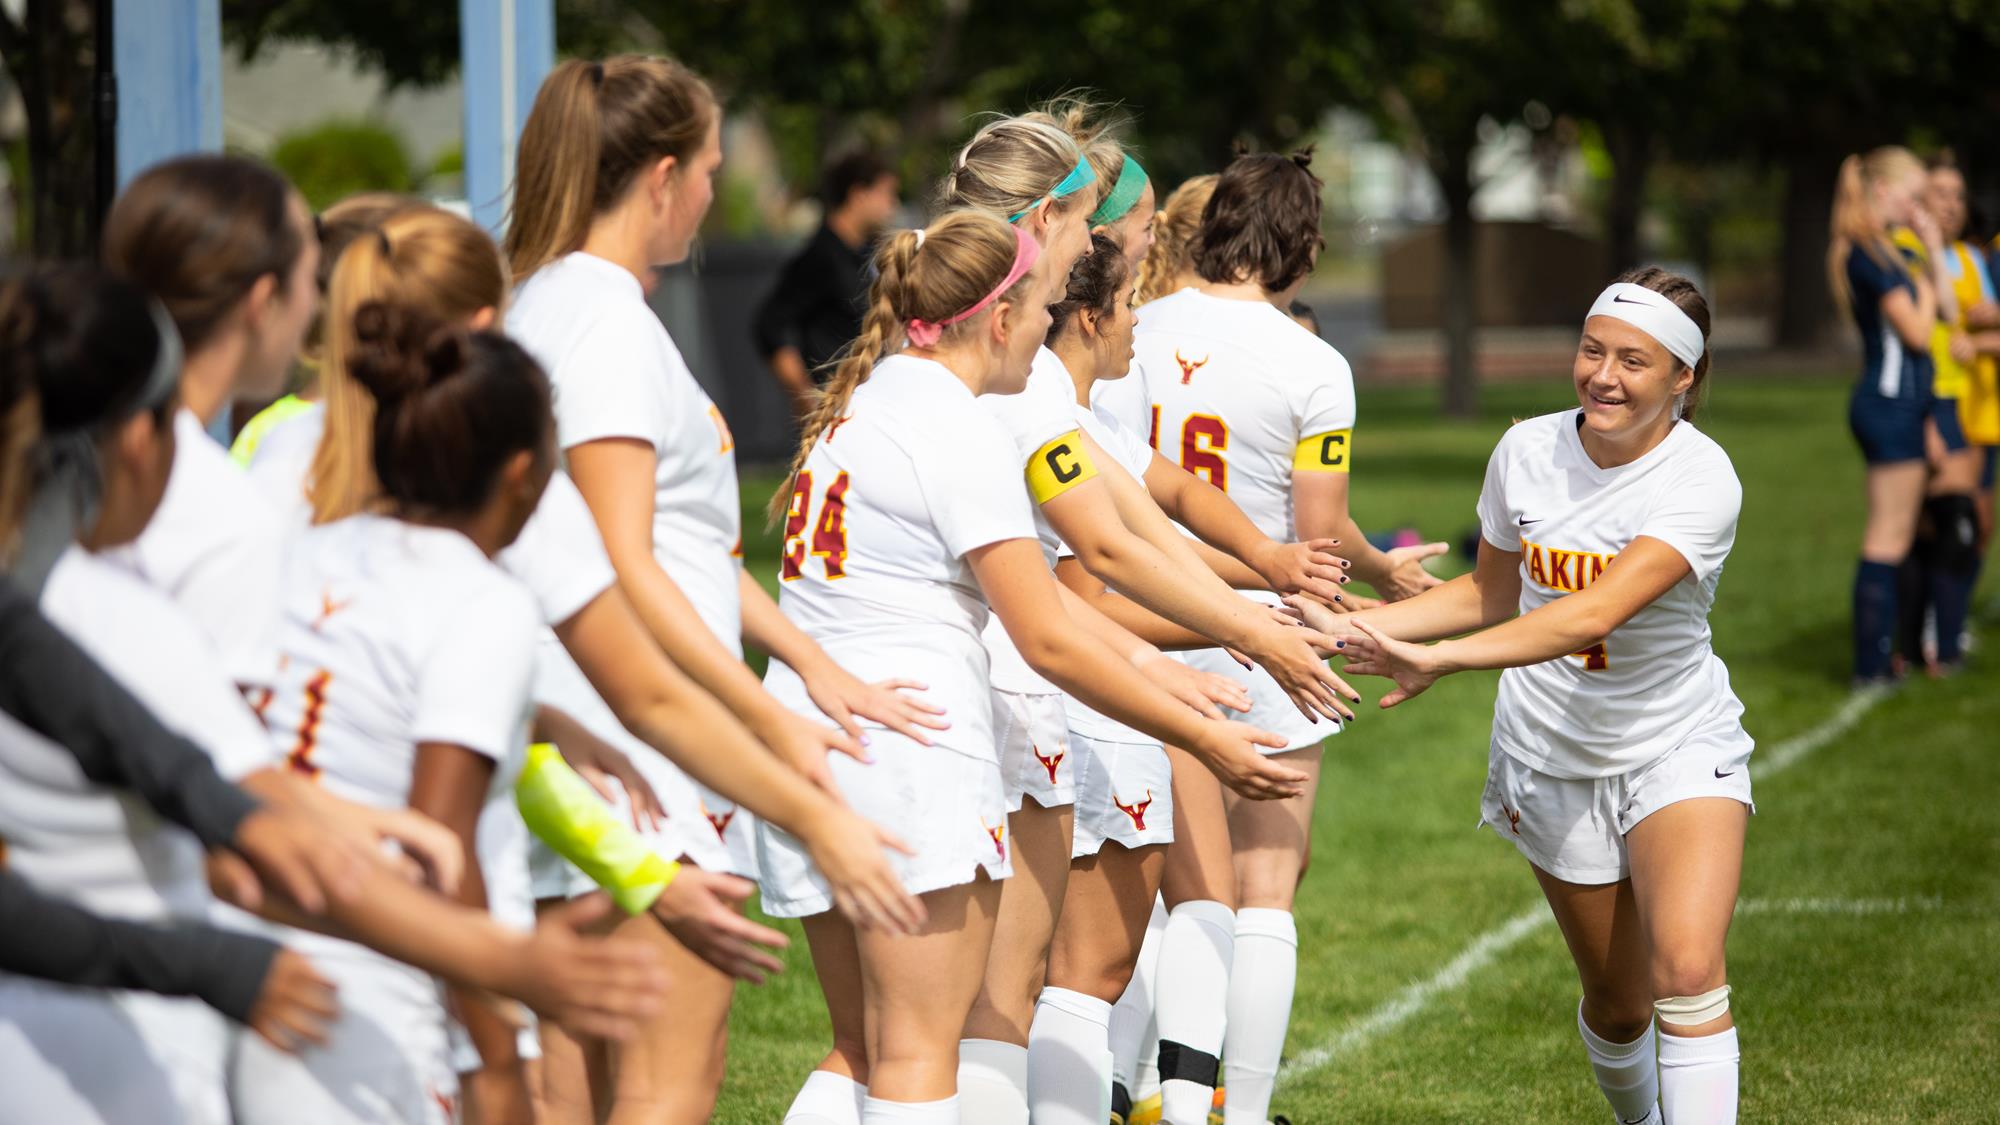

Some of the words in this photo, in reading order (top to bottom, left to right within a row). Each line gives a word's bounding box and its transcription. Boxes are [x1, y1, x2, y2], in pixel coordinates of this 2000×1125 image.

[1046, 443, 1082, 484] C
[1320, 436, 1345, 465] C
[782, 469, 849, 581] 24
[1521, 537, 1618, 592] AKI
